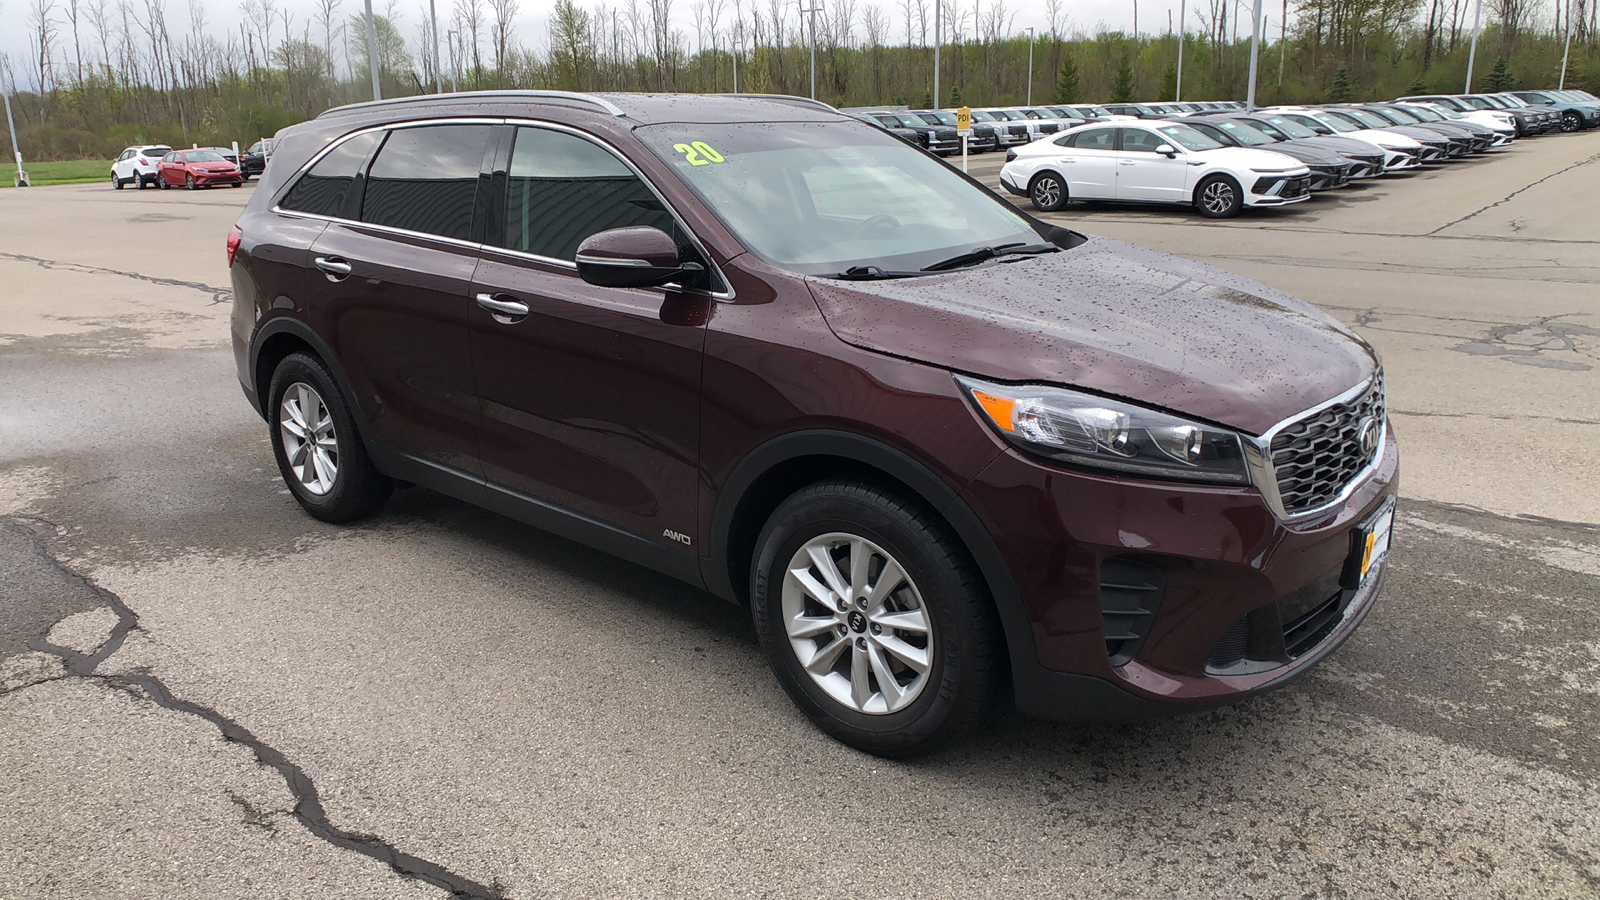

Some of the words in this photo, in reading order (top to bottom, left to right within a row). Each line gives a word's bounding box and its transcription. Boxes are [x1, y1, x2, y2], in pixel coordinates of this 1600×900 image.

[958, 113, 970, 122] PDI
[673, 141, 726, 167] 20
[663, 528, 692, 546] AWD
[851, 613, 863, 630] KIA
